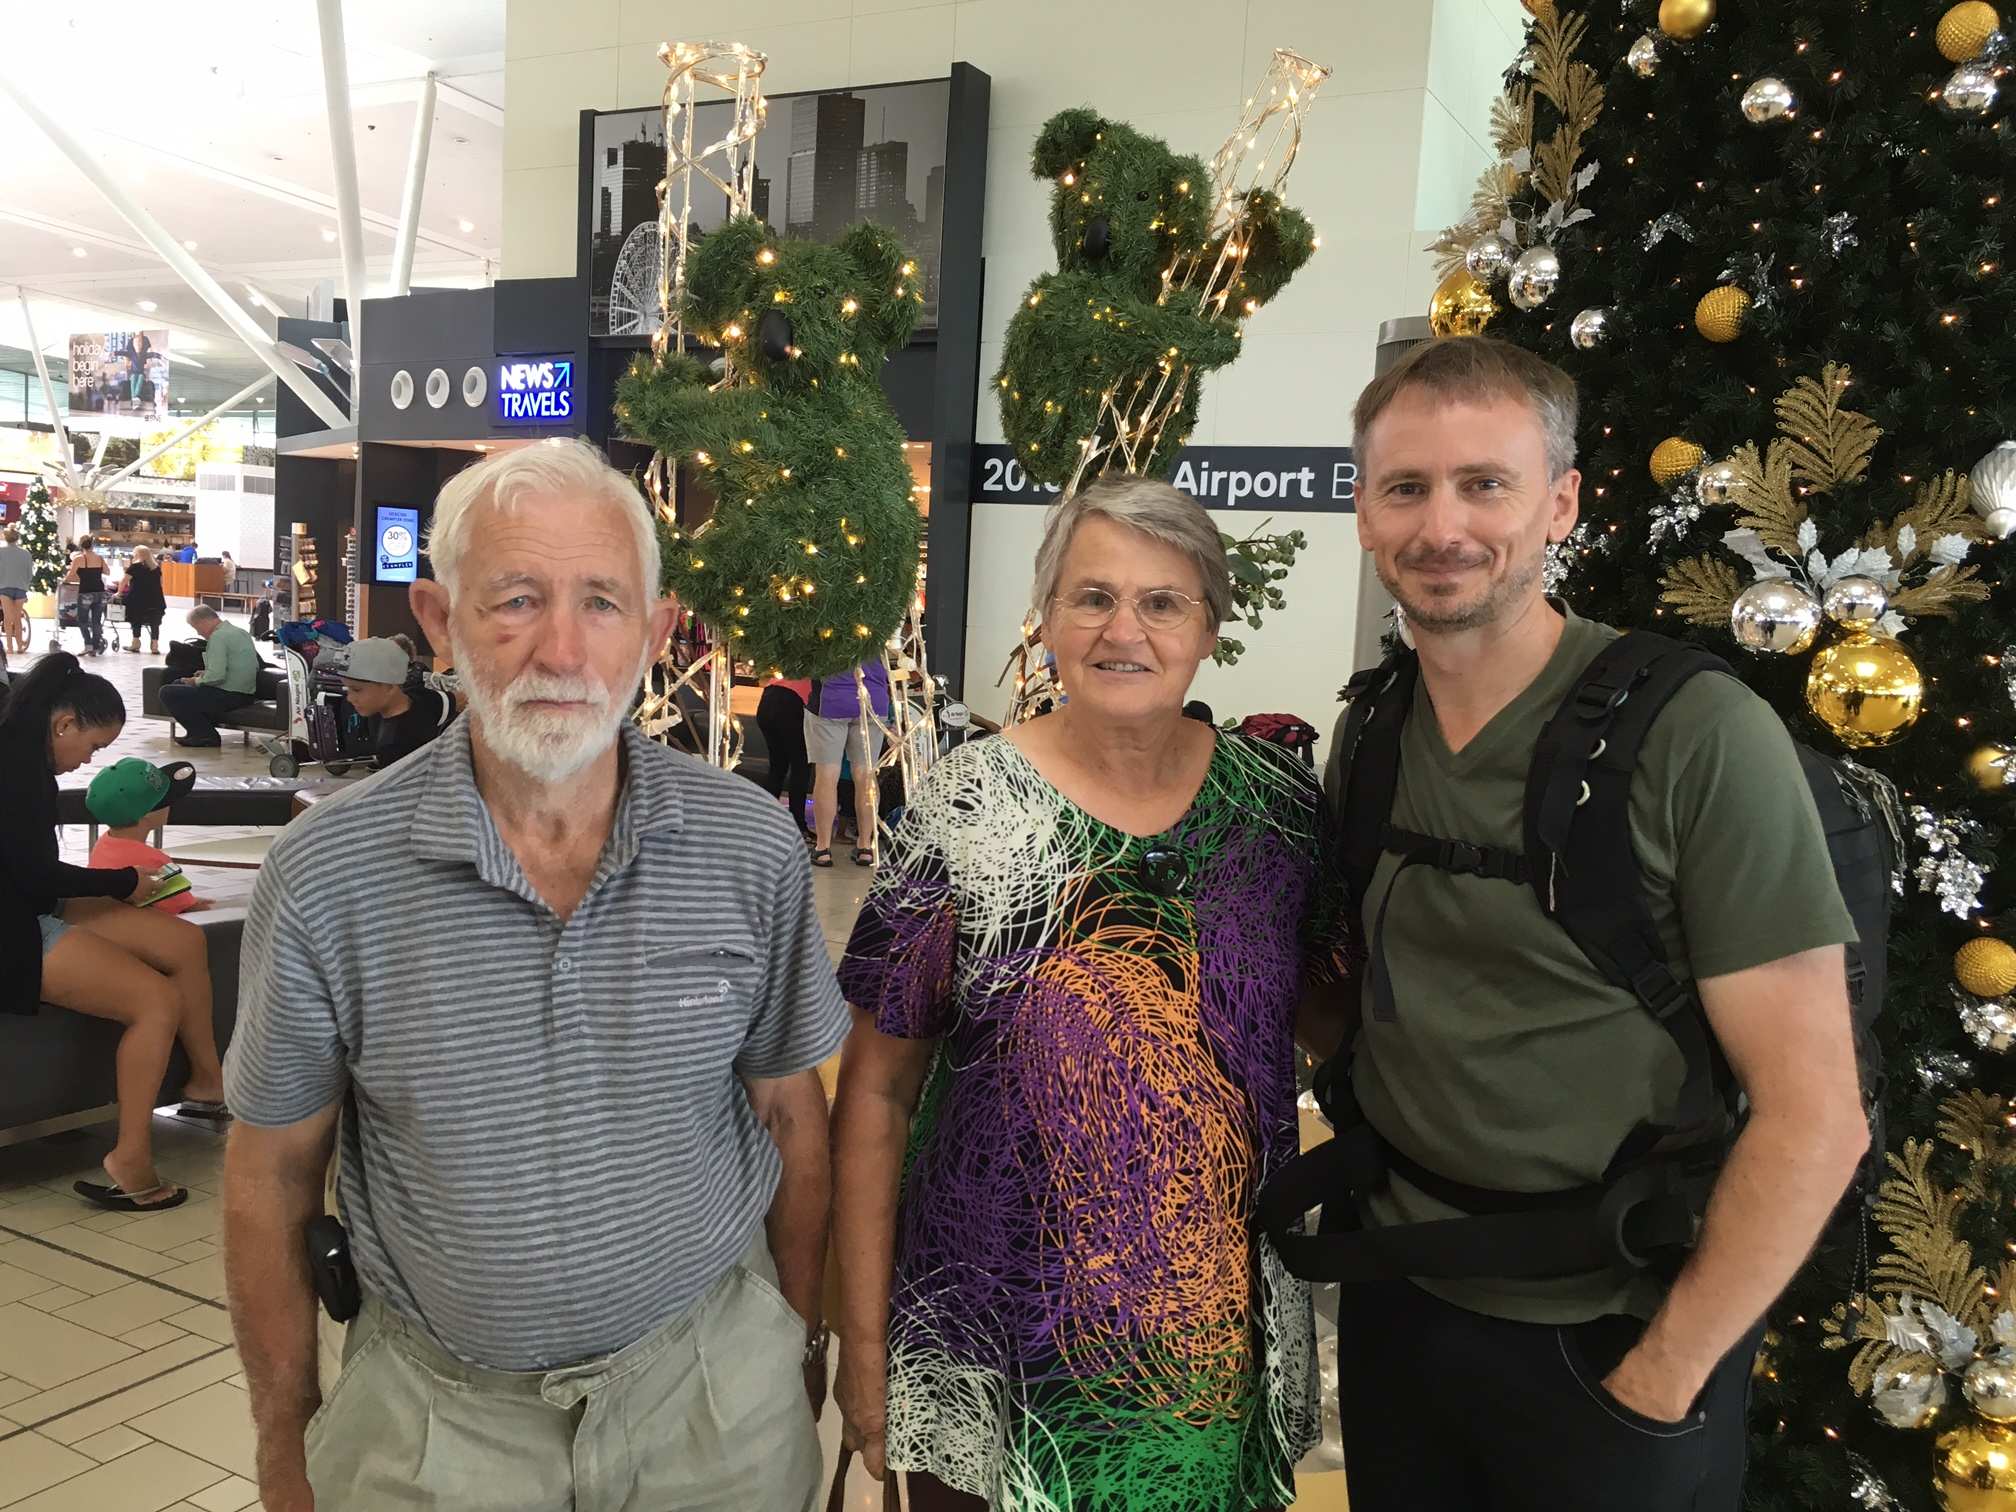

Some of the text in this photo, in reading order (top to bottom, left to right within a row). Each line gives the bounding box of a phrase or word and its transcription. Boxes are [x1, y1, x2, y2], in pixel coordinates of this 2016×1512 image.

[73, 358, 98, 375] begin
[501, 362, 554, 390] NEWS
[501, 390, 570, 417] TRAVELS
[1173, 461, 1315, 506] Airport
